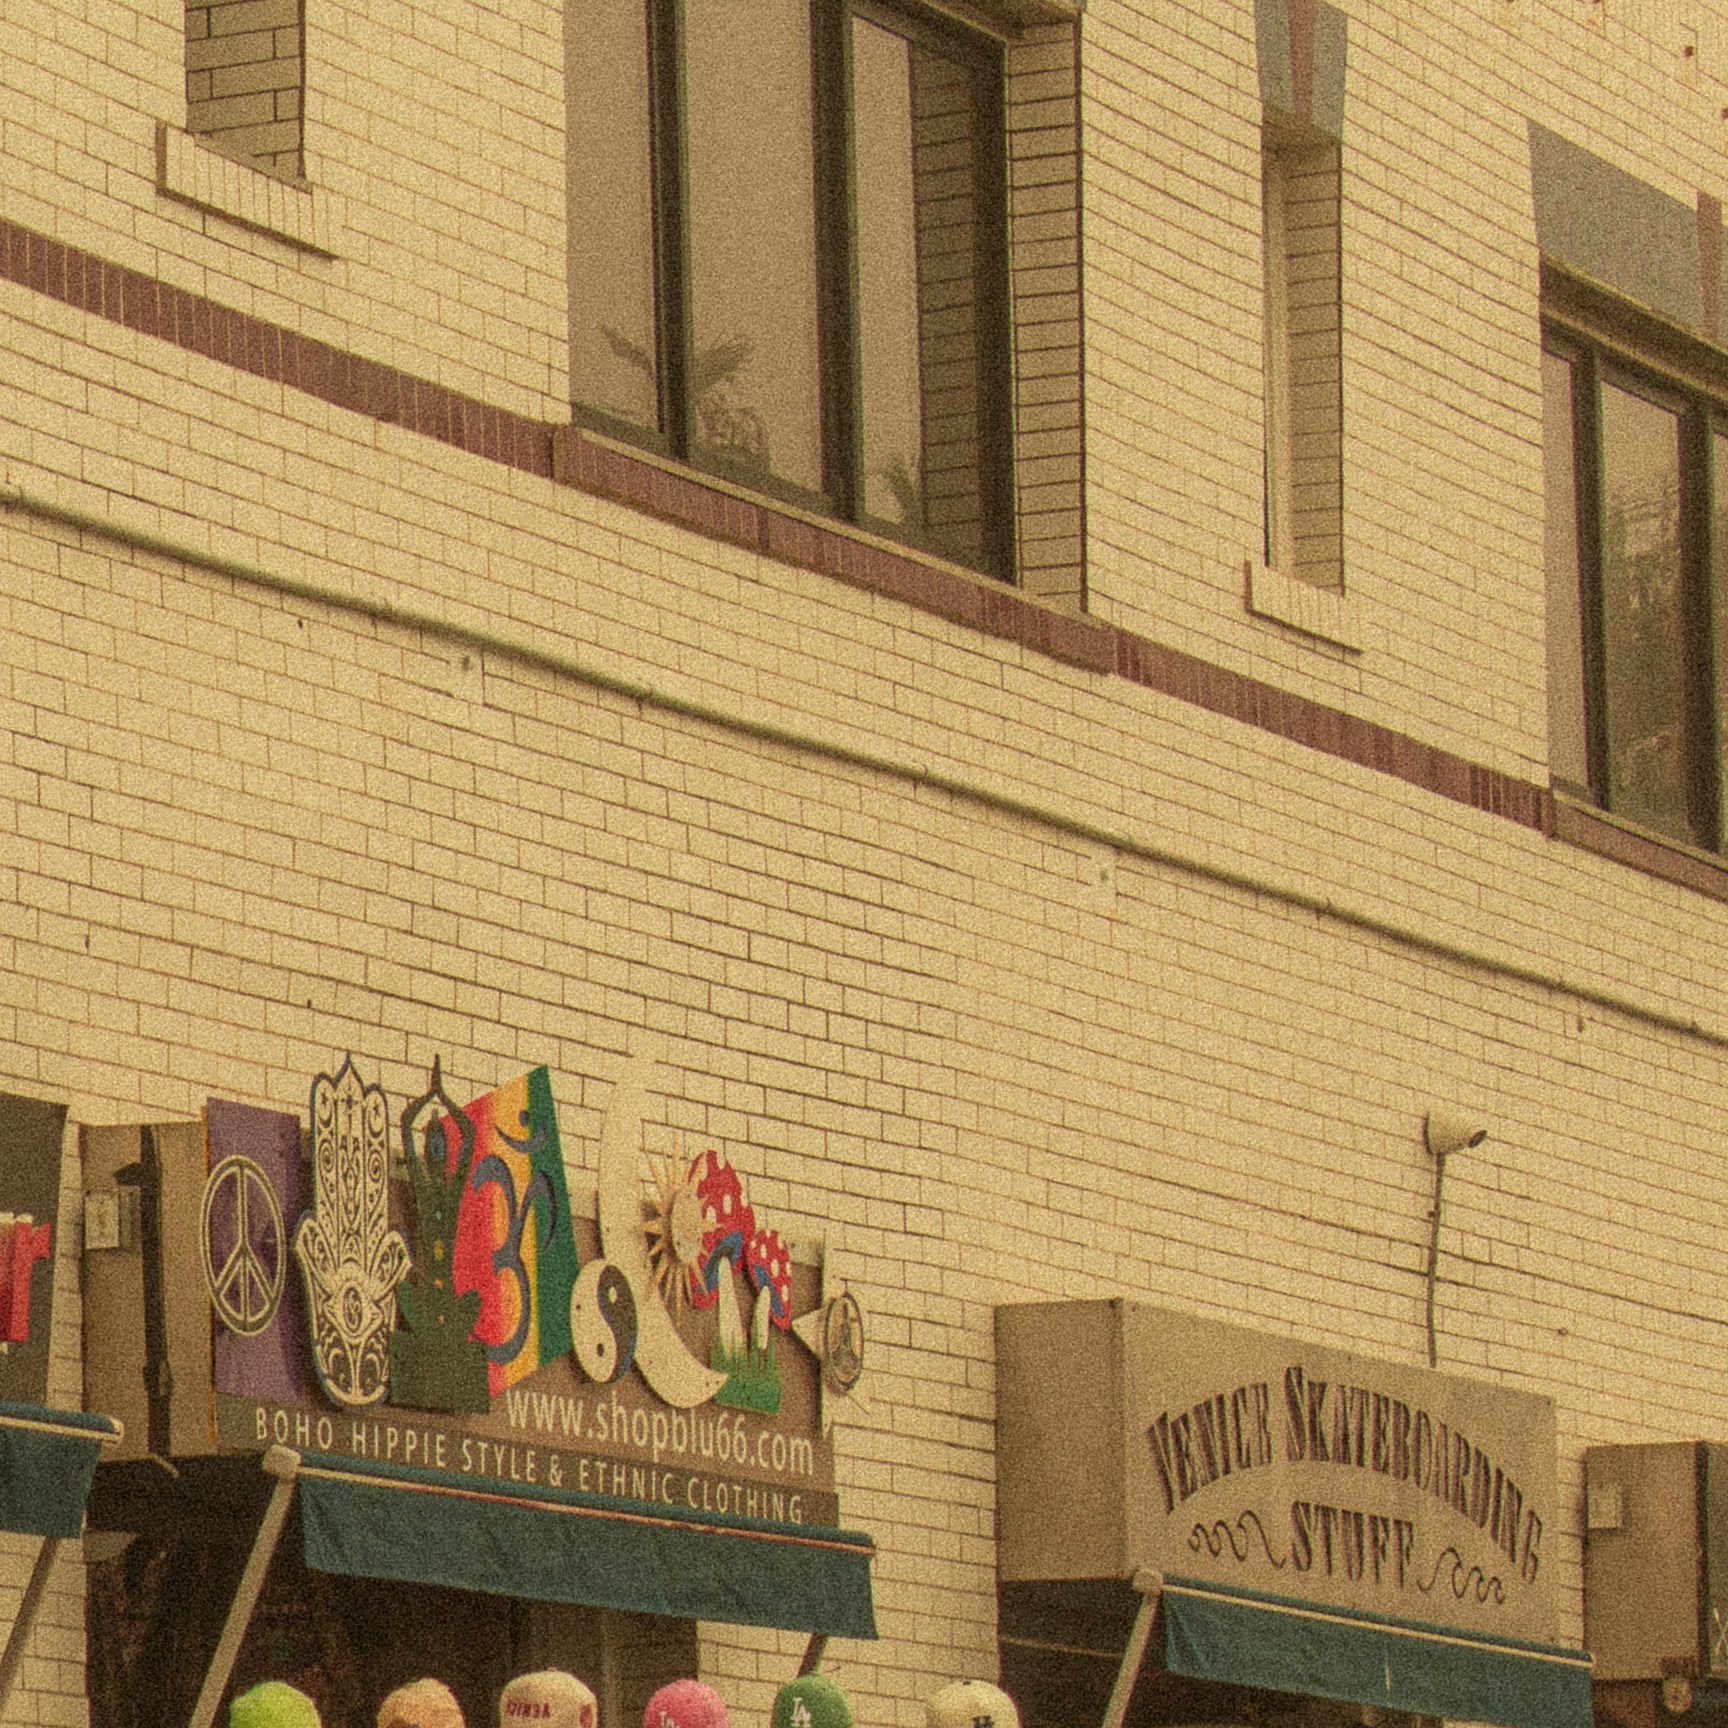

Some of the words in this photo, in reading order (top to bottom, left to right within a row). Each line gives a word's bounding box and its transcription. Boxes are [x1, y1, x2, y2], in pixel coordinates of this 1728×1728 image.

[255, 1406, 333, 1451] BOHO
[352, 1420, 447, 1468] HIPPIE
[461, 1437, 538, 1484] STYLE
[549, 1453, 563, 1488] &
[578, 1458, 674, 1505] ETHNIC
[687, 1476, 803, 1526] CLOTHING
[506, 1388, 814, 1477] www.shopblu66.com
